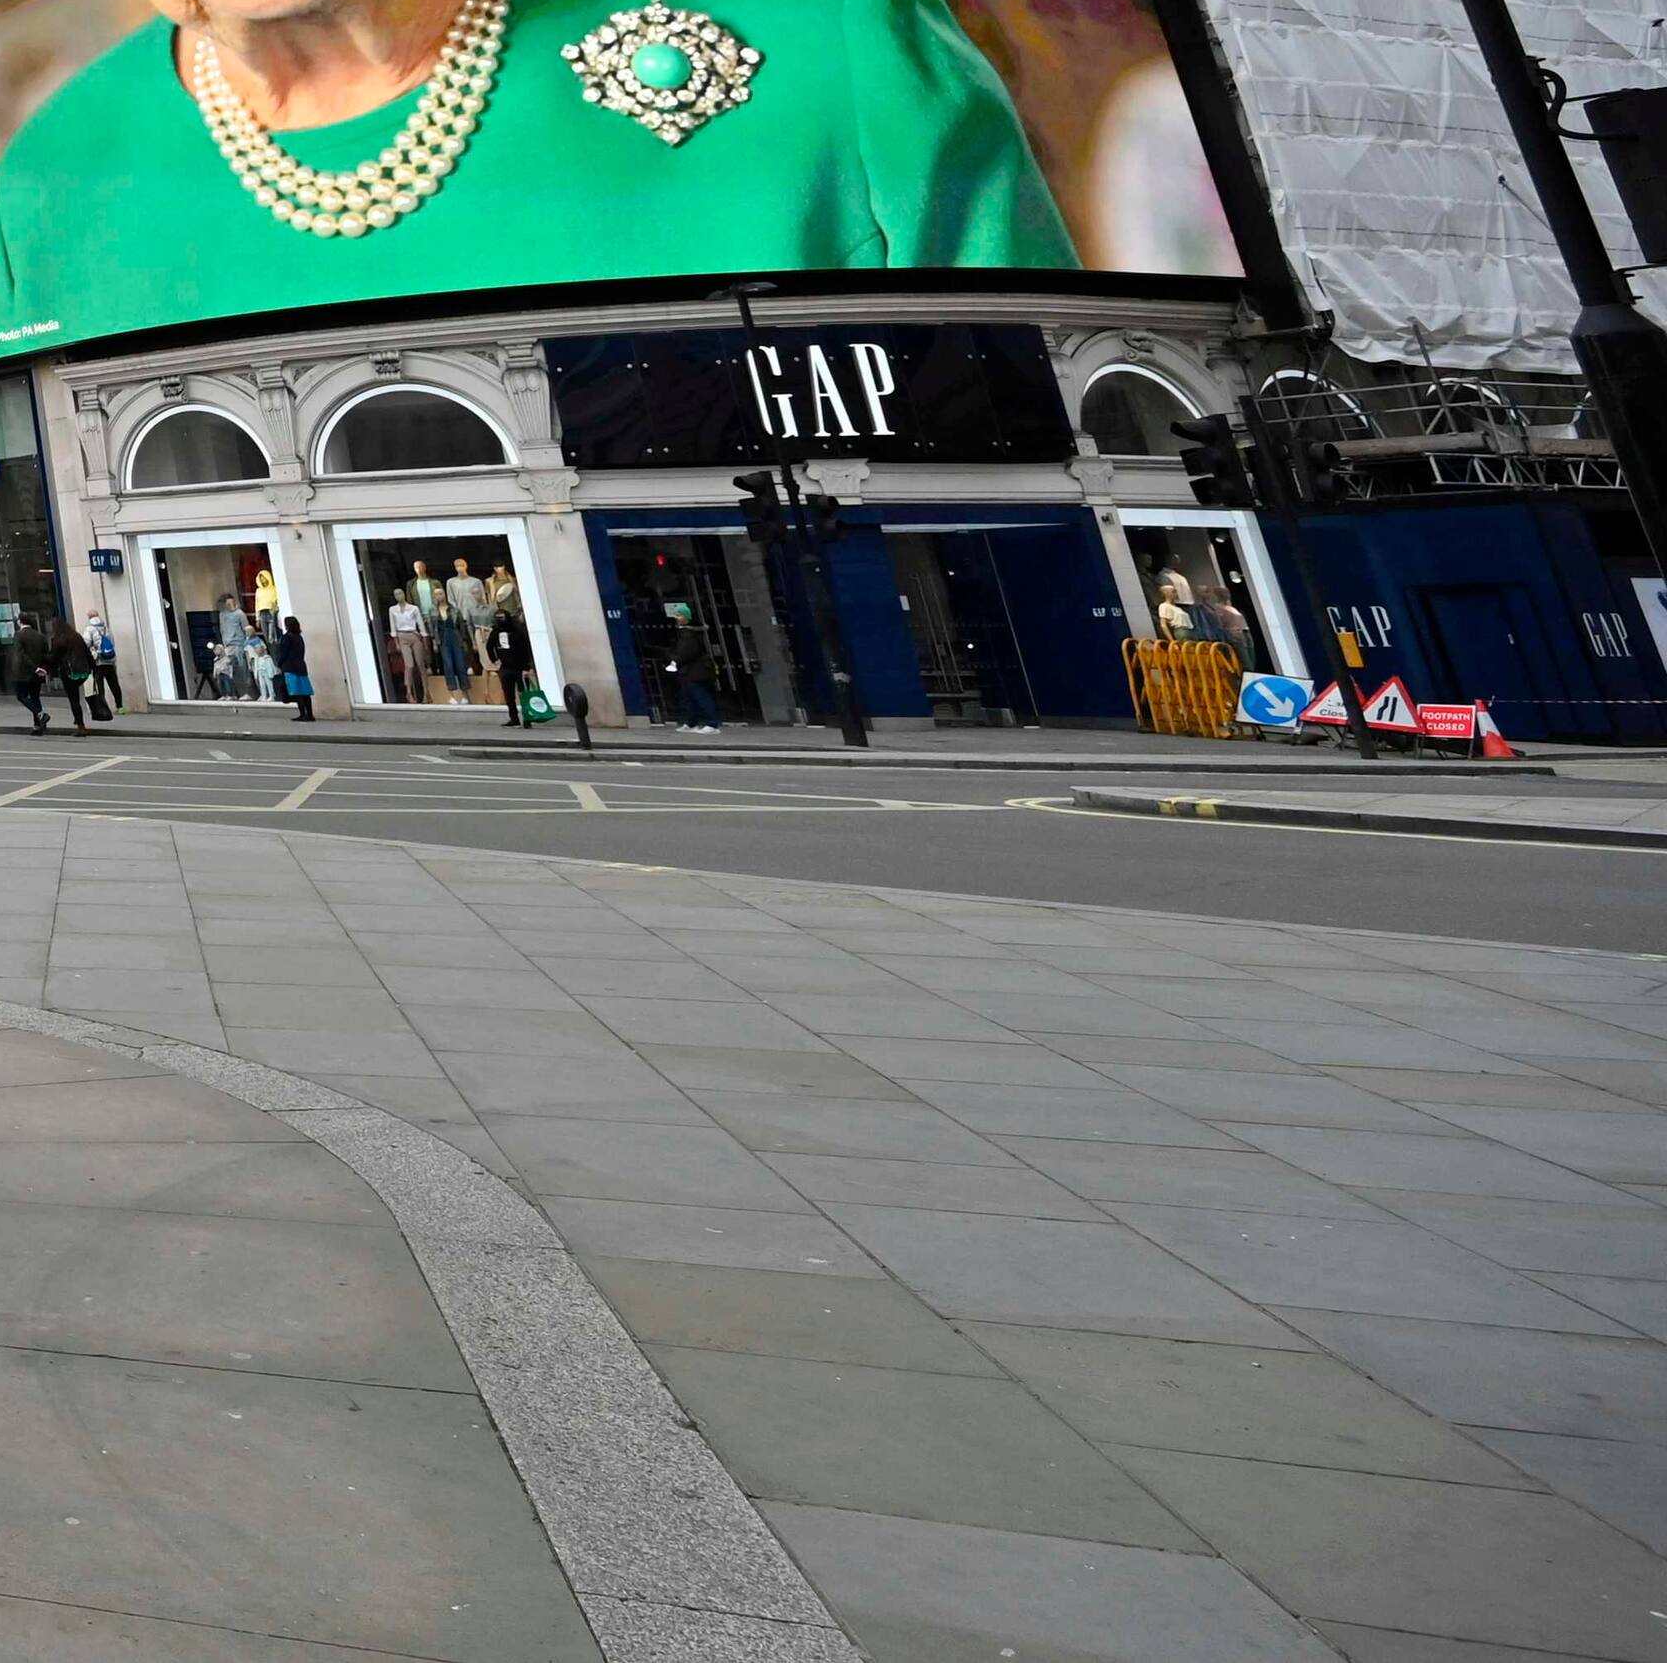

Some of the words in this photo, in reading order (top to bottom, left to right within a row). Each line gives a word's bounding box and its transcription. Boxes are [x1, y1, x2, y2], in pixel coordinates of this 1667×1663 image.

[21, 325, 34, 338] PA
[33, 319, 60, 335] Media
[746, 343, 896, 438] GAP
[92, 555, 105, 567] GAP
[1582, 612, 1632, 657] GAP
[1421, 710, 1471, 722] FOOTPATH
[1426, 722, 1466, 732] CLOSED
